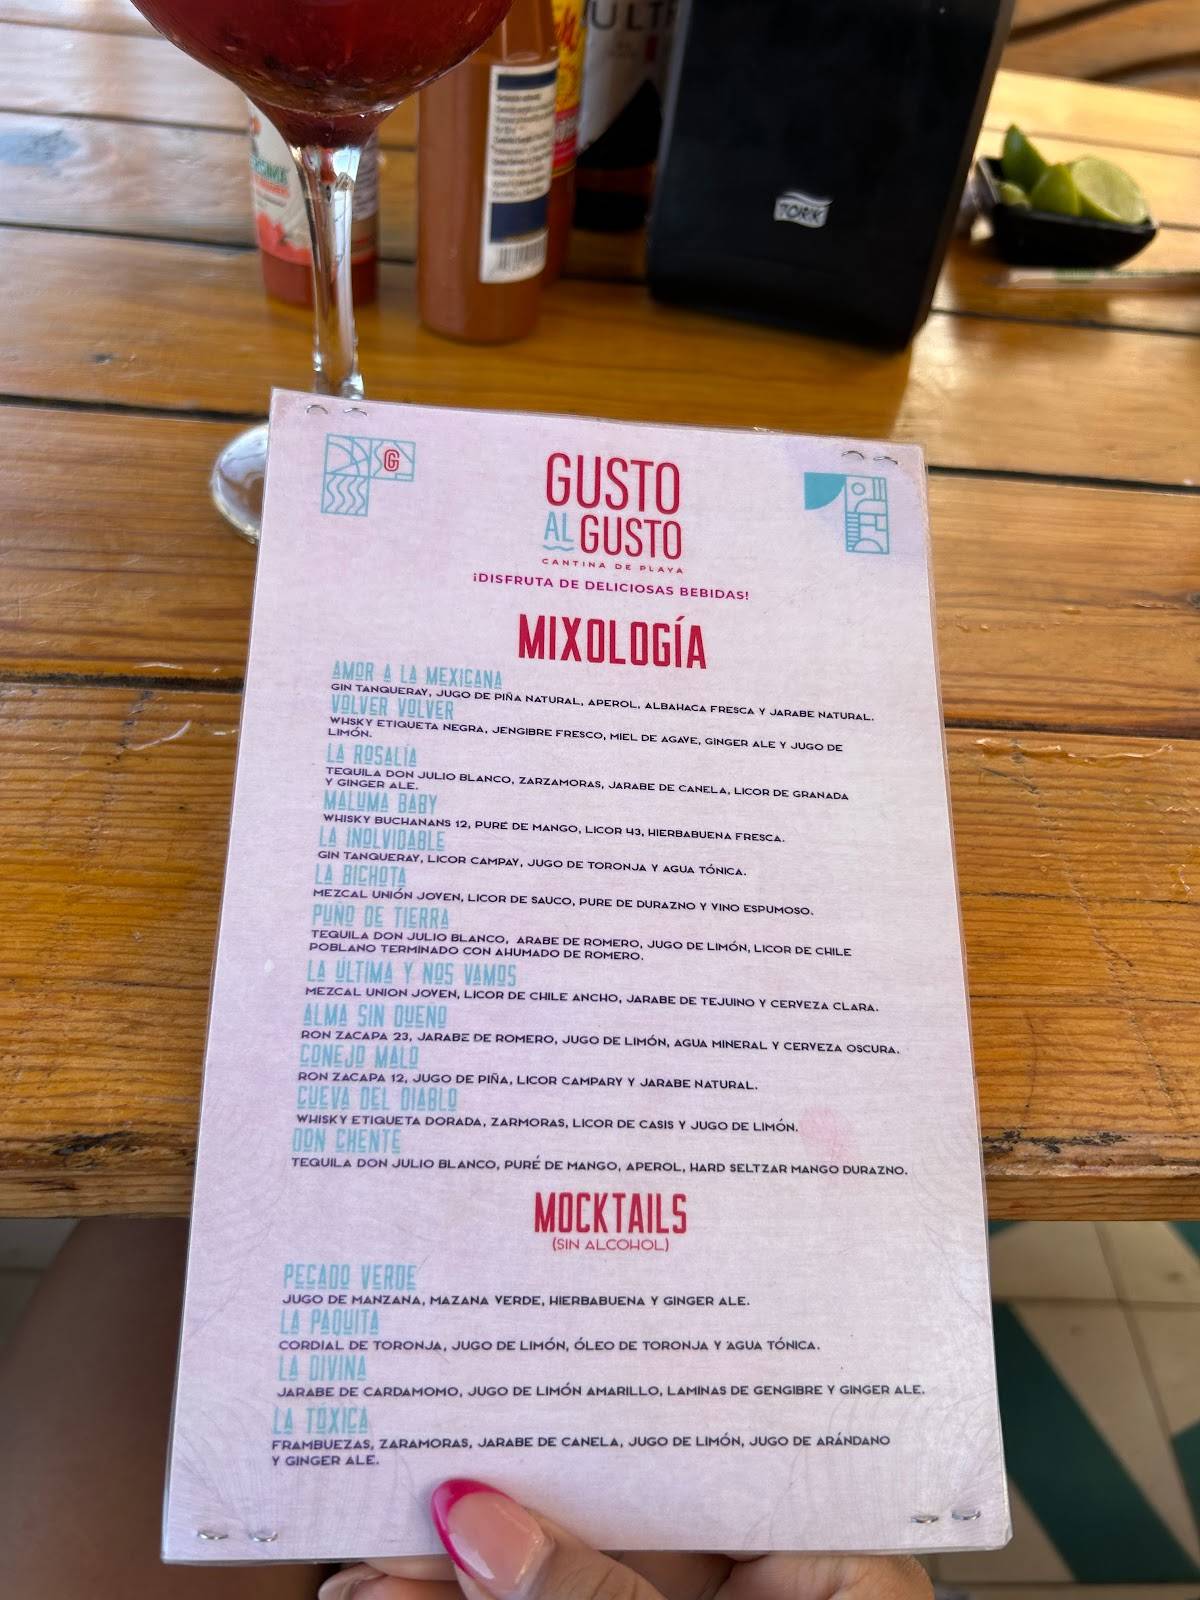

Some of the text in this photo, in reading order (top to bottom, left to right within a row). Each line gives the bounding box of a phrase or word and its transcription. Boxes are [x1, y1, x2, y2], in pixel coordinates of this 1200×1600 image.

[546, 452, 680, 515] GUSTO
[544, 511, 682, 560] AL GUSTO
[541, 558, 683, 574] CANTINA DE PLAYA
[473, 572, 749, 600] ¡DISFRUTA DE DELICIOSAS BEBIDAS!
[518, 613, 707, 670] MIXOLOGÍA
[332, 660, 503, 689] AMOR A LA MEXICANA
[331, 683, 874, 721] GIN TANQUERAY, JUGO DE PIÑA NATURAL, APEROL, ALBAHACA FRESCA Y JARABE NATURAL.
[331, 694, 454, 720] VOLVER VOLVER
[328, 726, 372, 738] LIMÓN.
[377, 719, 439, 730] ETIQUETA
[443, 723, 488, 734] NEGRA,
[491, 726, 553, 737] JENGIBRE
[555, 729, 607, 741] FRESCO,
[610, 733, 638, 742] MIEL
[641, 734, 658, 743] DE
[660, 735, 701, 746] AGAVE,
[704, 737, 749, 747] GINGER
[752, 740, 776, 749] ALE
[779, 741, 787, 749] Y
[790, 742, 824, 751] JUGO
[827, 744, 843, 752] DE
[326, 743, 345, 764] LA
[323, 790, 438, 814] MALUMA BABY
[319, 826, 445, 853] LA INOLVIDABLE
[315, 864, 406, 888] LA BICHOTA
[317, 850, 747, 876] GIN TANQUERAY, LICOR CAMPAY, JUGO DE TORONJA Y AGUA TÓNICA.
[313, 888, 814, 916] MEZCAL UNIÓN JOVEN, LICOR DE SAUCO, PURE DE DURAZNO Y VINO ESPUMOSO.
[364, 905, 383, 928] DE
[396, 907, 449, 929] TIERRA
[306, 960, 326, 982] LA
[404, 963, 412, 981] Y
[422, 963, 453, 985] NOS
[464, 964, 516, 987] VAMOS
[303, 1003, 347, 1027] ALMA
[358, 1004, 385, 1026] SIN
[299, 1043, 419, 1069] CONEJO MALO
[298, 1072, 758, 1090] RON ZACAPA 12, JUGO DE PIÑA, LICOR CAMPARY Y JARABE NATURAL.
[297, 1085, 458, 1113] CUEVA DEL DIABLO
[292, 1128, 400, 1155] DON CHENTE
[291, 1155, 908, 1175] TEQUILA DON JULIO BLANCO, PURÉ DE MANGO, APEROL, HARD SELTZAR MANGO DURAZNO.
[534, 1191, 687, 1235] MOCKTAILS
[552, 1237, 669, 1252] (SIN ALCOHOL)
[283, 1263, 416, 1292] PECADO VERDE
[282, 1294, 750, 1307] JUGO DE MANZANA, MAZANA VERDE, HIERBABUENA Y GINGER ALE.
[280, 1309, 379, 1336] LA PAQUITA
[278, 1355, 366, 1382] LA DIVINA
[272, 1407, 293, 1435] LA
[272, 1432, 890, 1451] FRAMBUEZAS, ZARAMORAS, JARABE DE CANELA, JUGO DE LIMÓN, JUGO DE ARÁNDANO
[272, 1454, 379, 1466] Y GINGER ALE.
